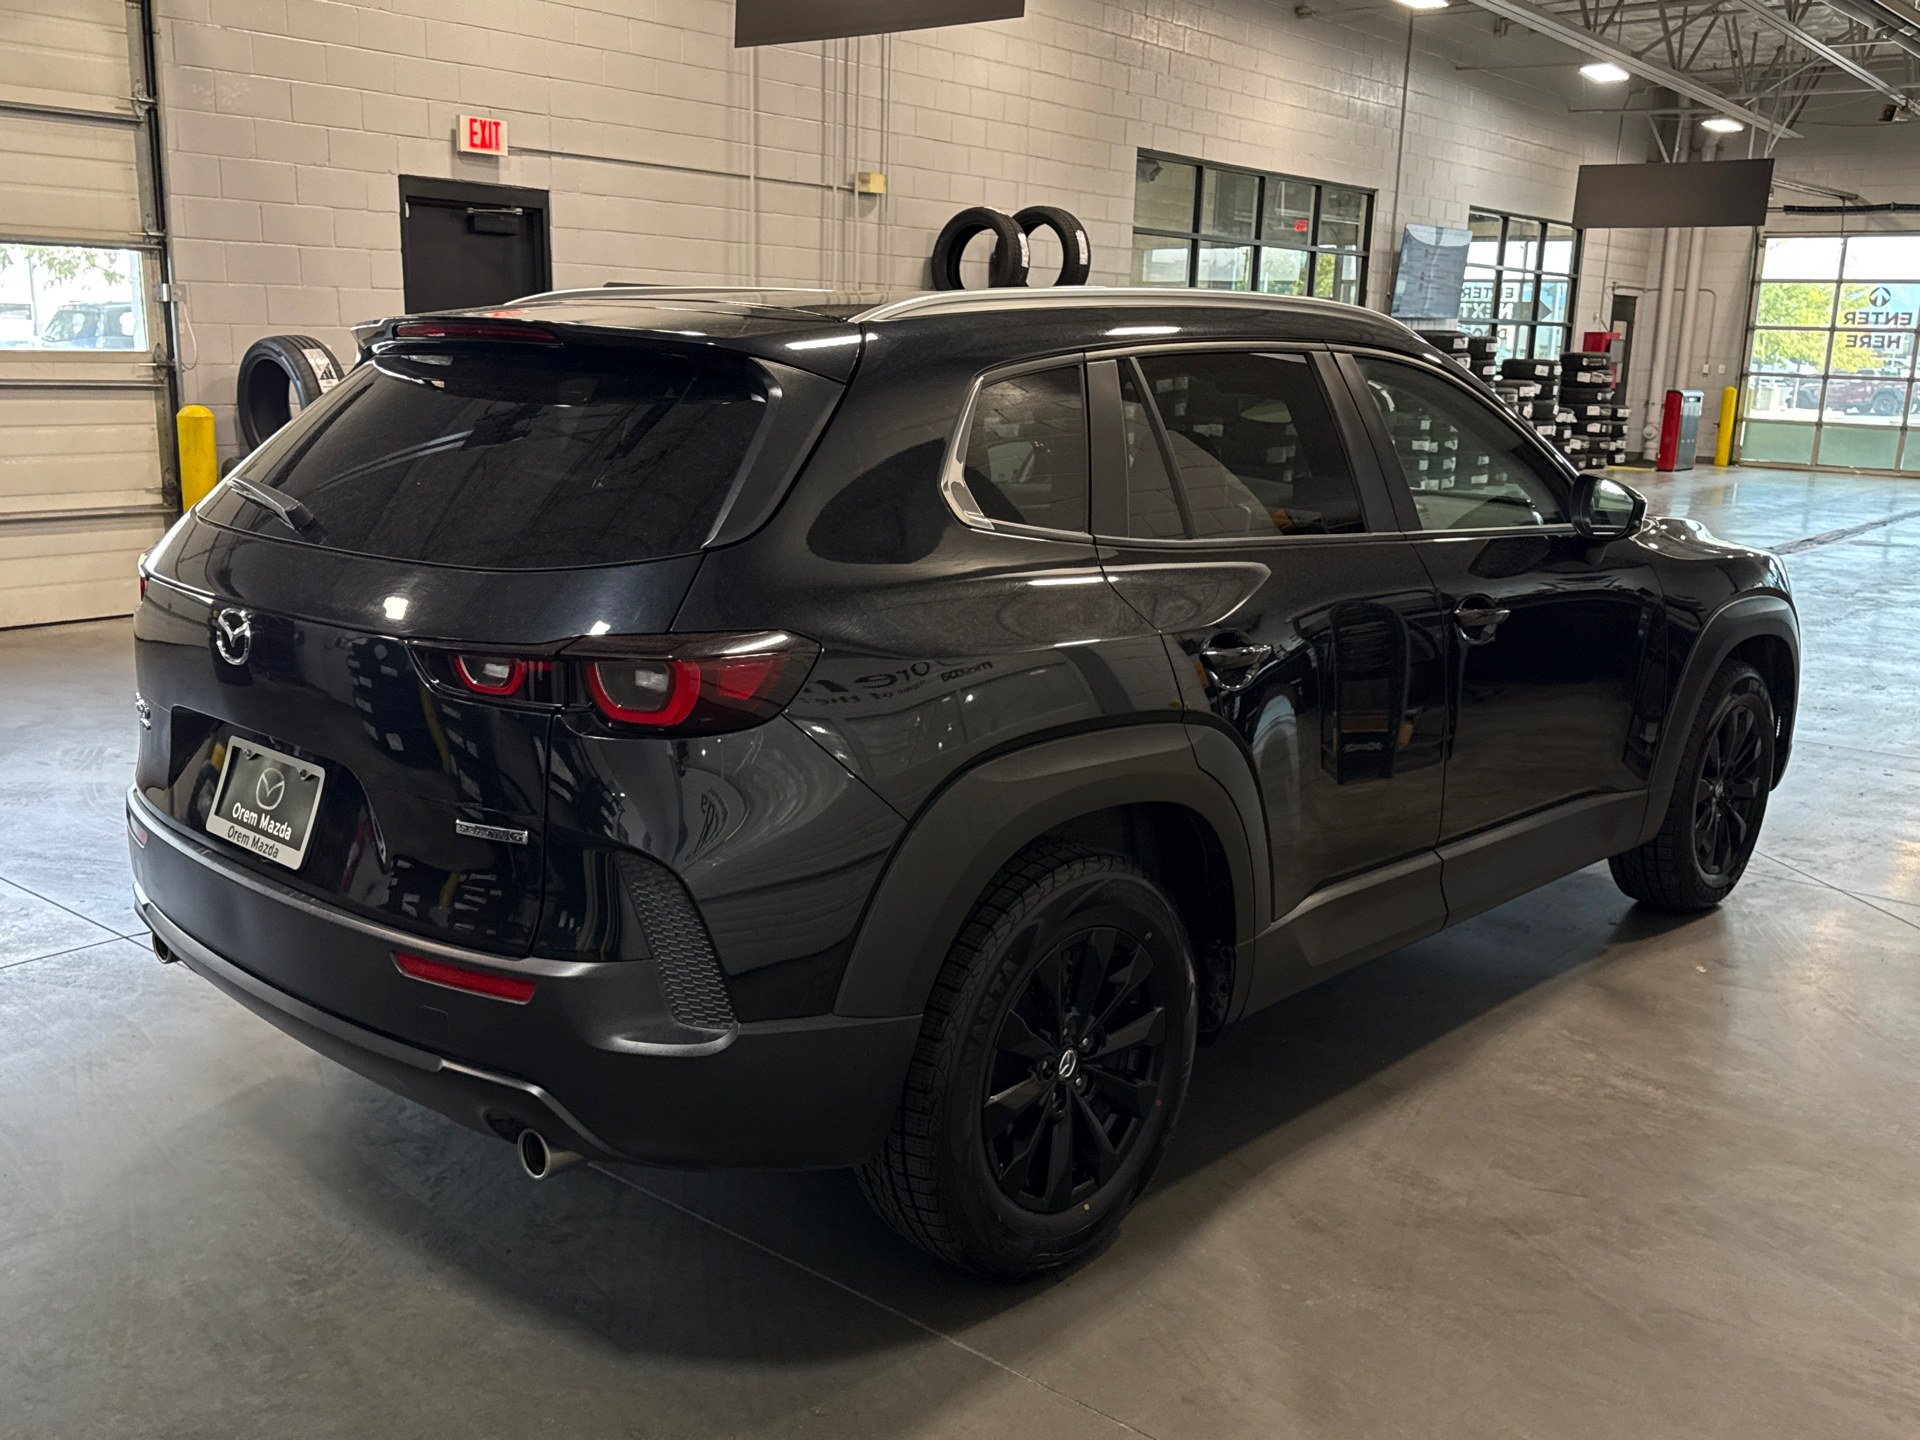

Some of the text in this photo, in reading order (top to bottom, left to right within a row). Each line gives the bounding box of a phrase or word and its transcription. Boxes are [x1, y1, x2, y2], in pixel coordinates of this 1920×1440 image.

[469, 117, 501, 152] EXIT
[232, 802, 292, 841] Orem Mazda
[227, 825, 279, 859] Orem Mazda
